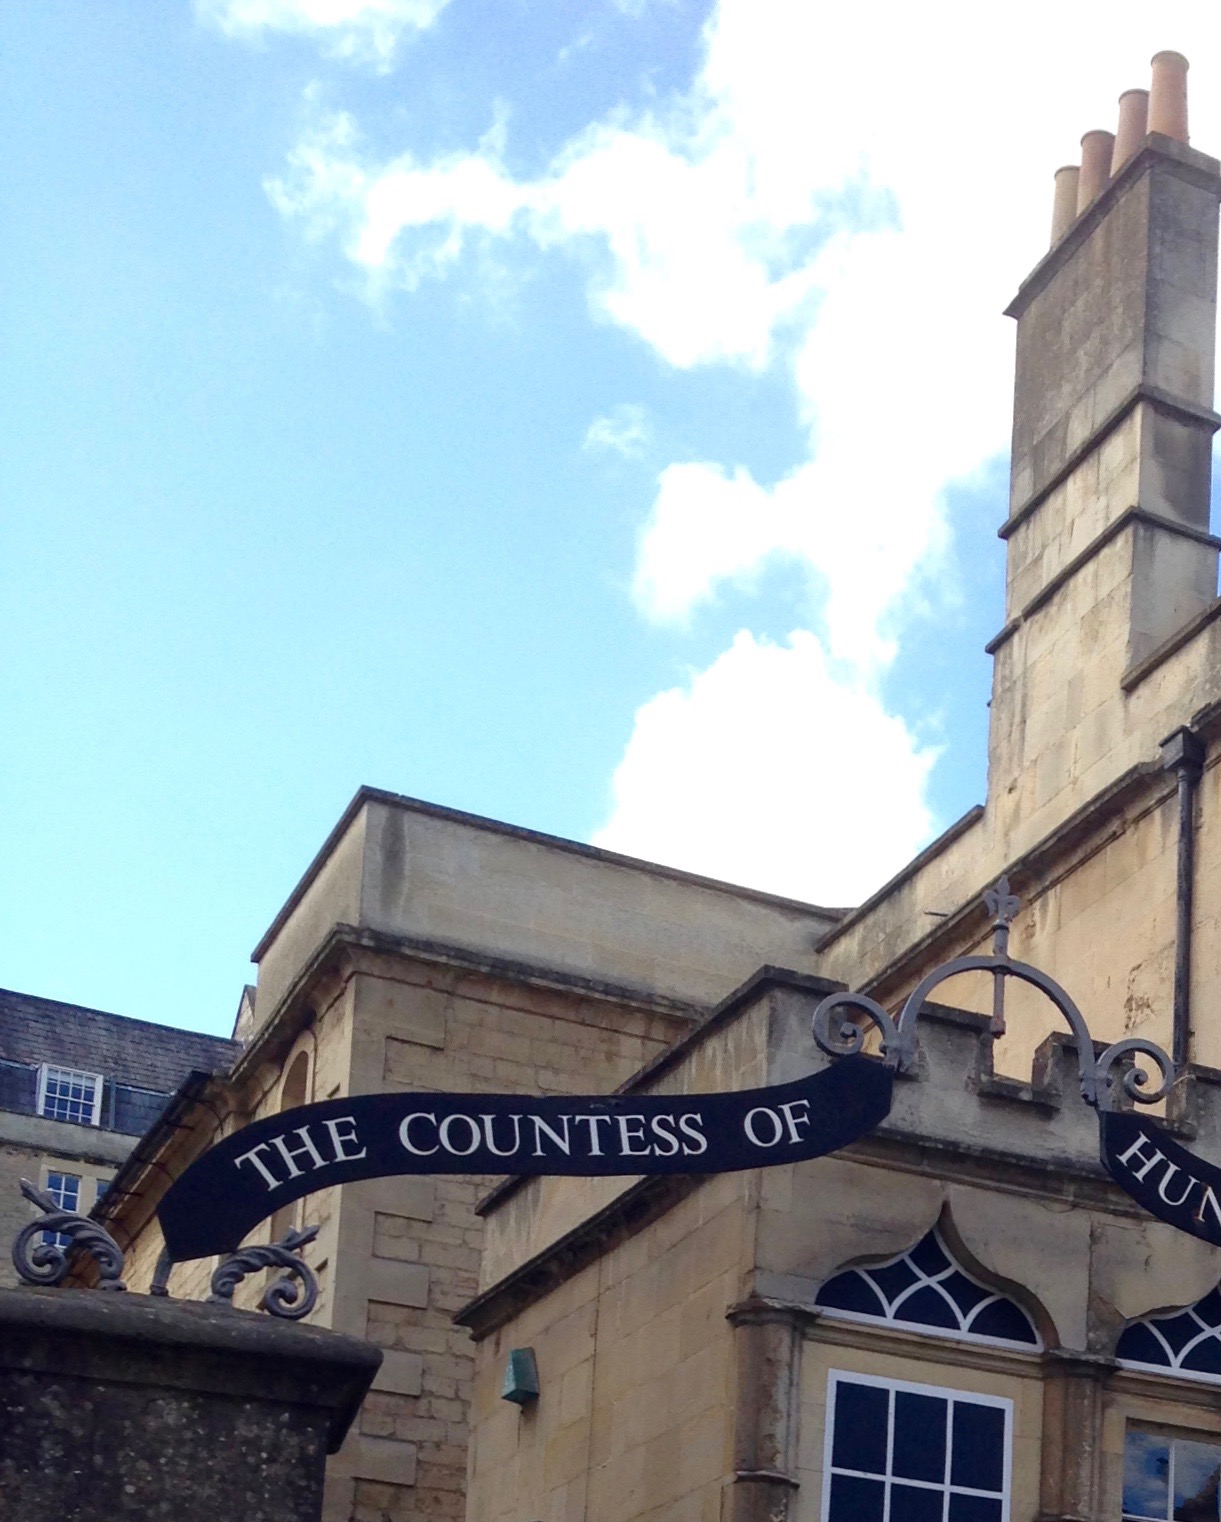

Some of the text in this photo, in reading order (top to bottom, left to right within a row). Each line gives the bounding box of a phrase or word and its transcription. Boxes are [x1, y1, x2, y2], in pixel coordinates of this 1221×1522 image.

[234, 1099, 812, 1192] THE COUNTESS OF
